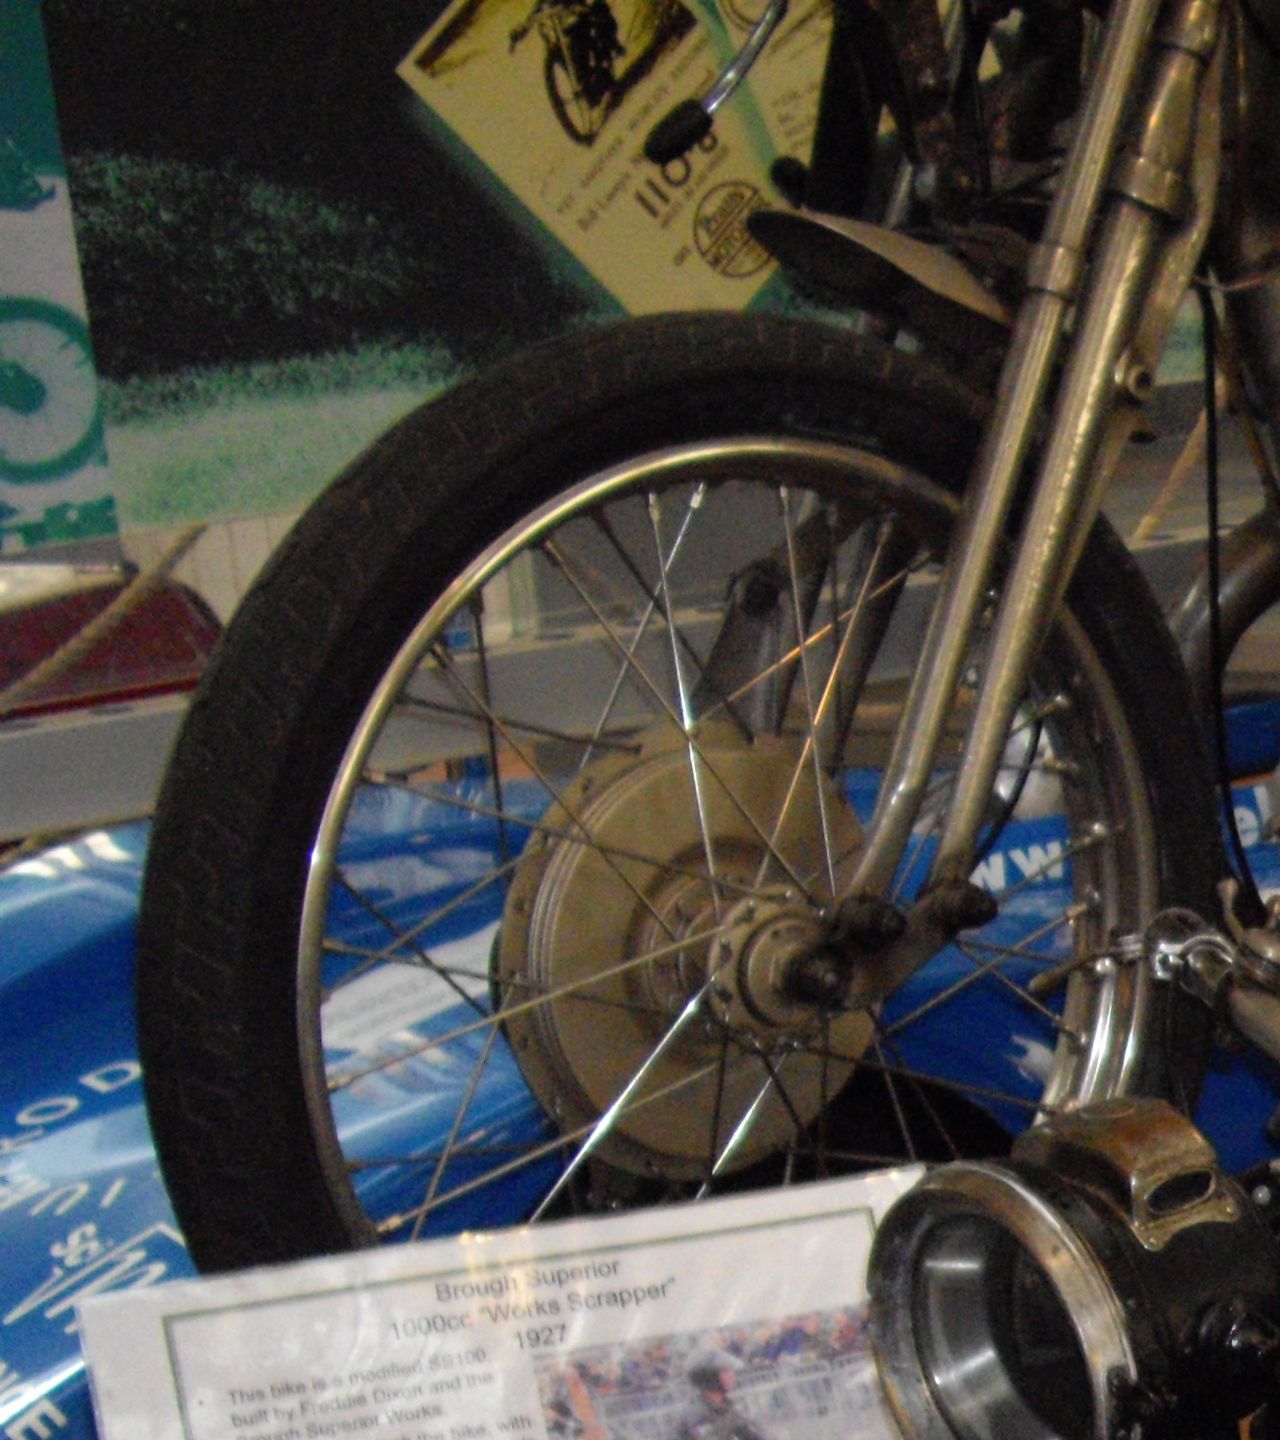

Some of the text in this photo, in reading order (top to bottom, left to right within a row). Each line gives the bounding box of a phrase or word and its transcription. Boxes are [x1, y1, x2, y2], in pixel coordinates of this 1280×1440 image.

[434, 1274, 518, 1304] Brough
[391, 1314, 471, 1340] 1000cc
[513, 1324, 570, 1350] 1927
